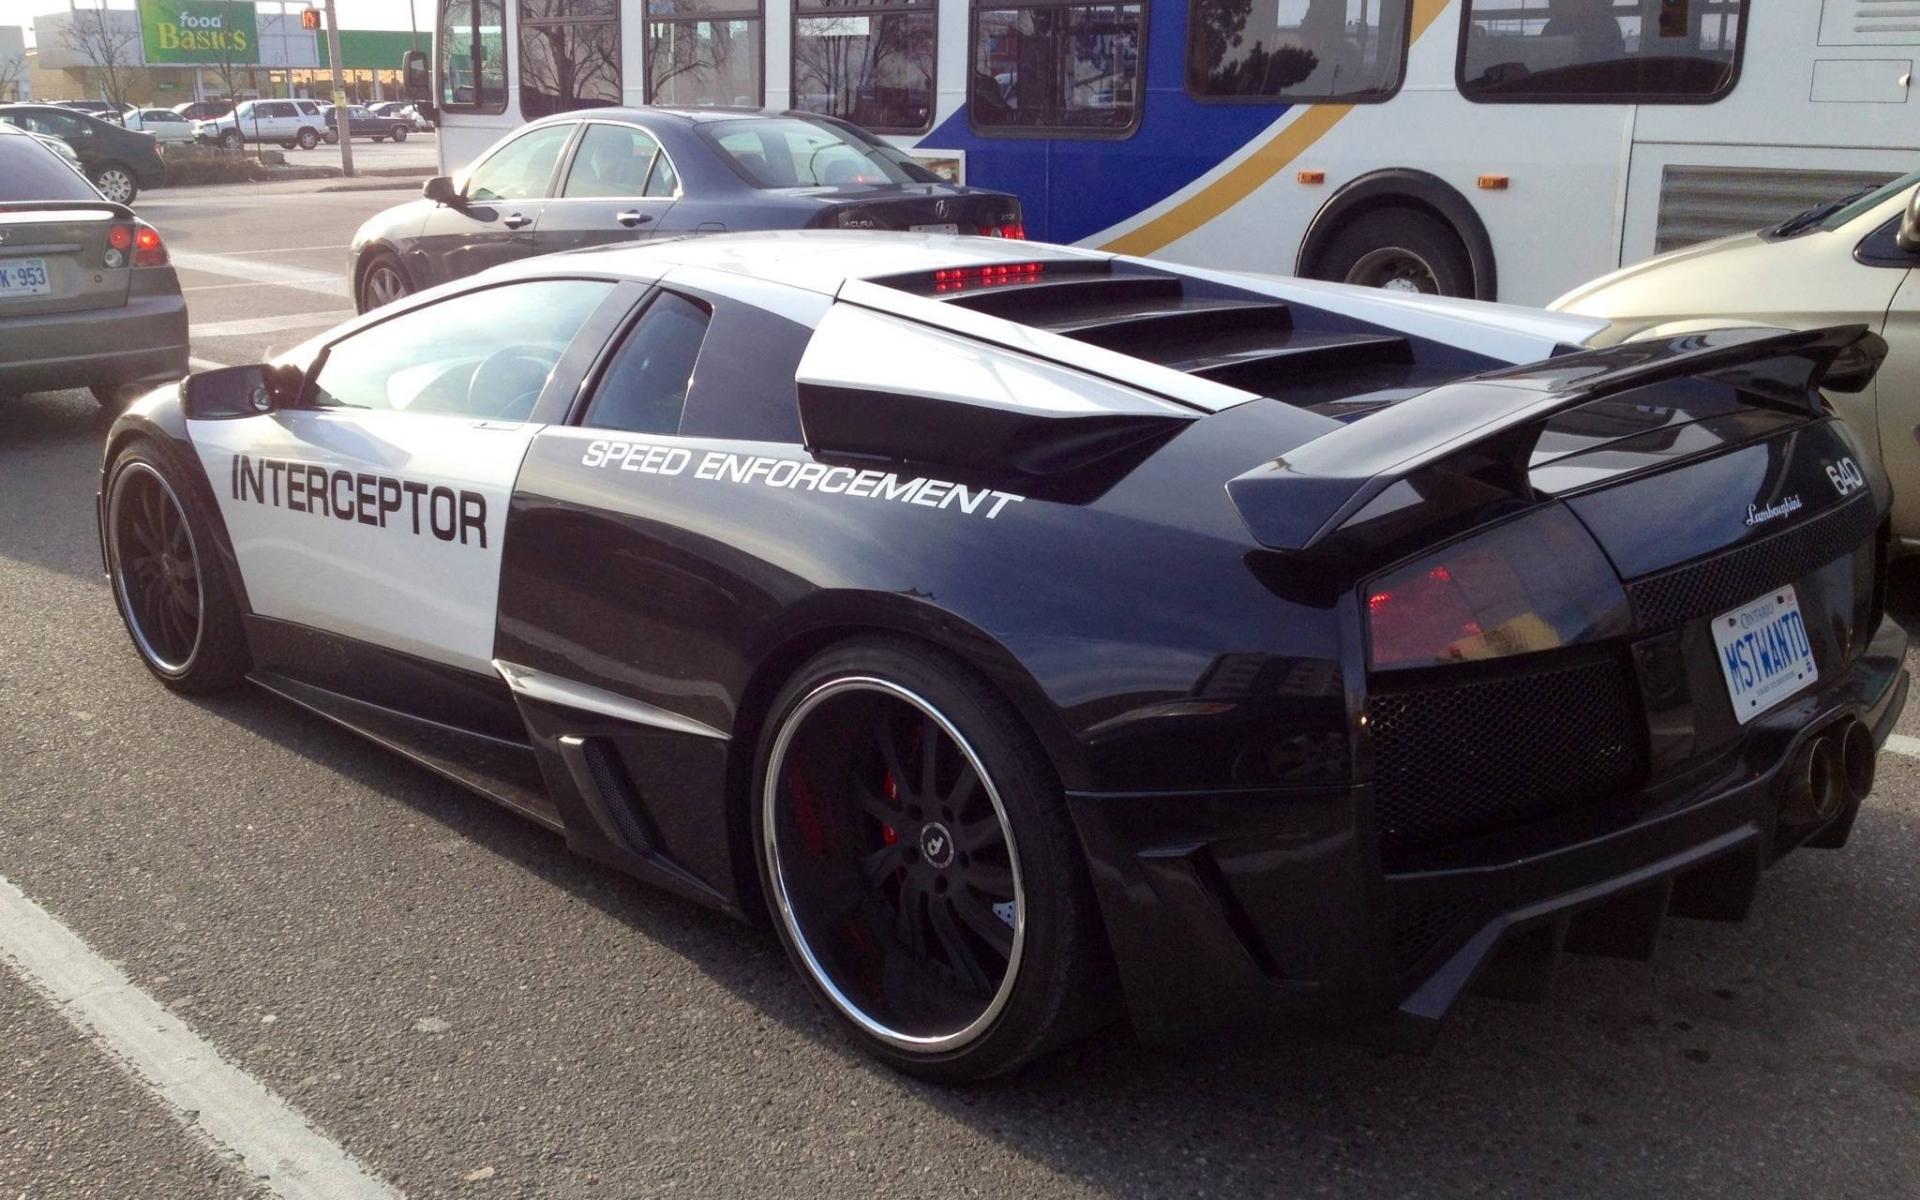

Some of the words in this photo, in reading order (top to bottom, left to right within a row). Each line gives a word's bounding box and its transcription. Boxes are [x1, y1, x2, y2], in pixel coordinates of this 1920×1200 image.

[179, 11, 222, 28] food
[17, 267, 46, 286] 953
[582, 440, 692, 476] SPEED
[696, 452, 1026, 520] ENFORCEMENT
[1826, 457, 1864, 496] 640
[232, 454, 488, 549] INTERCEPTOR
[1746, 494, 1803, 526] Lamborghini
[1724, 610, 1809, 696] MSTWANTD
